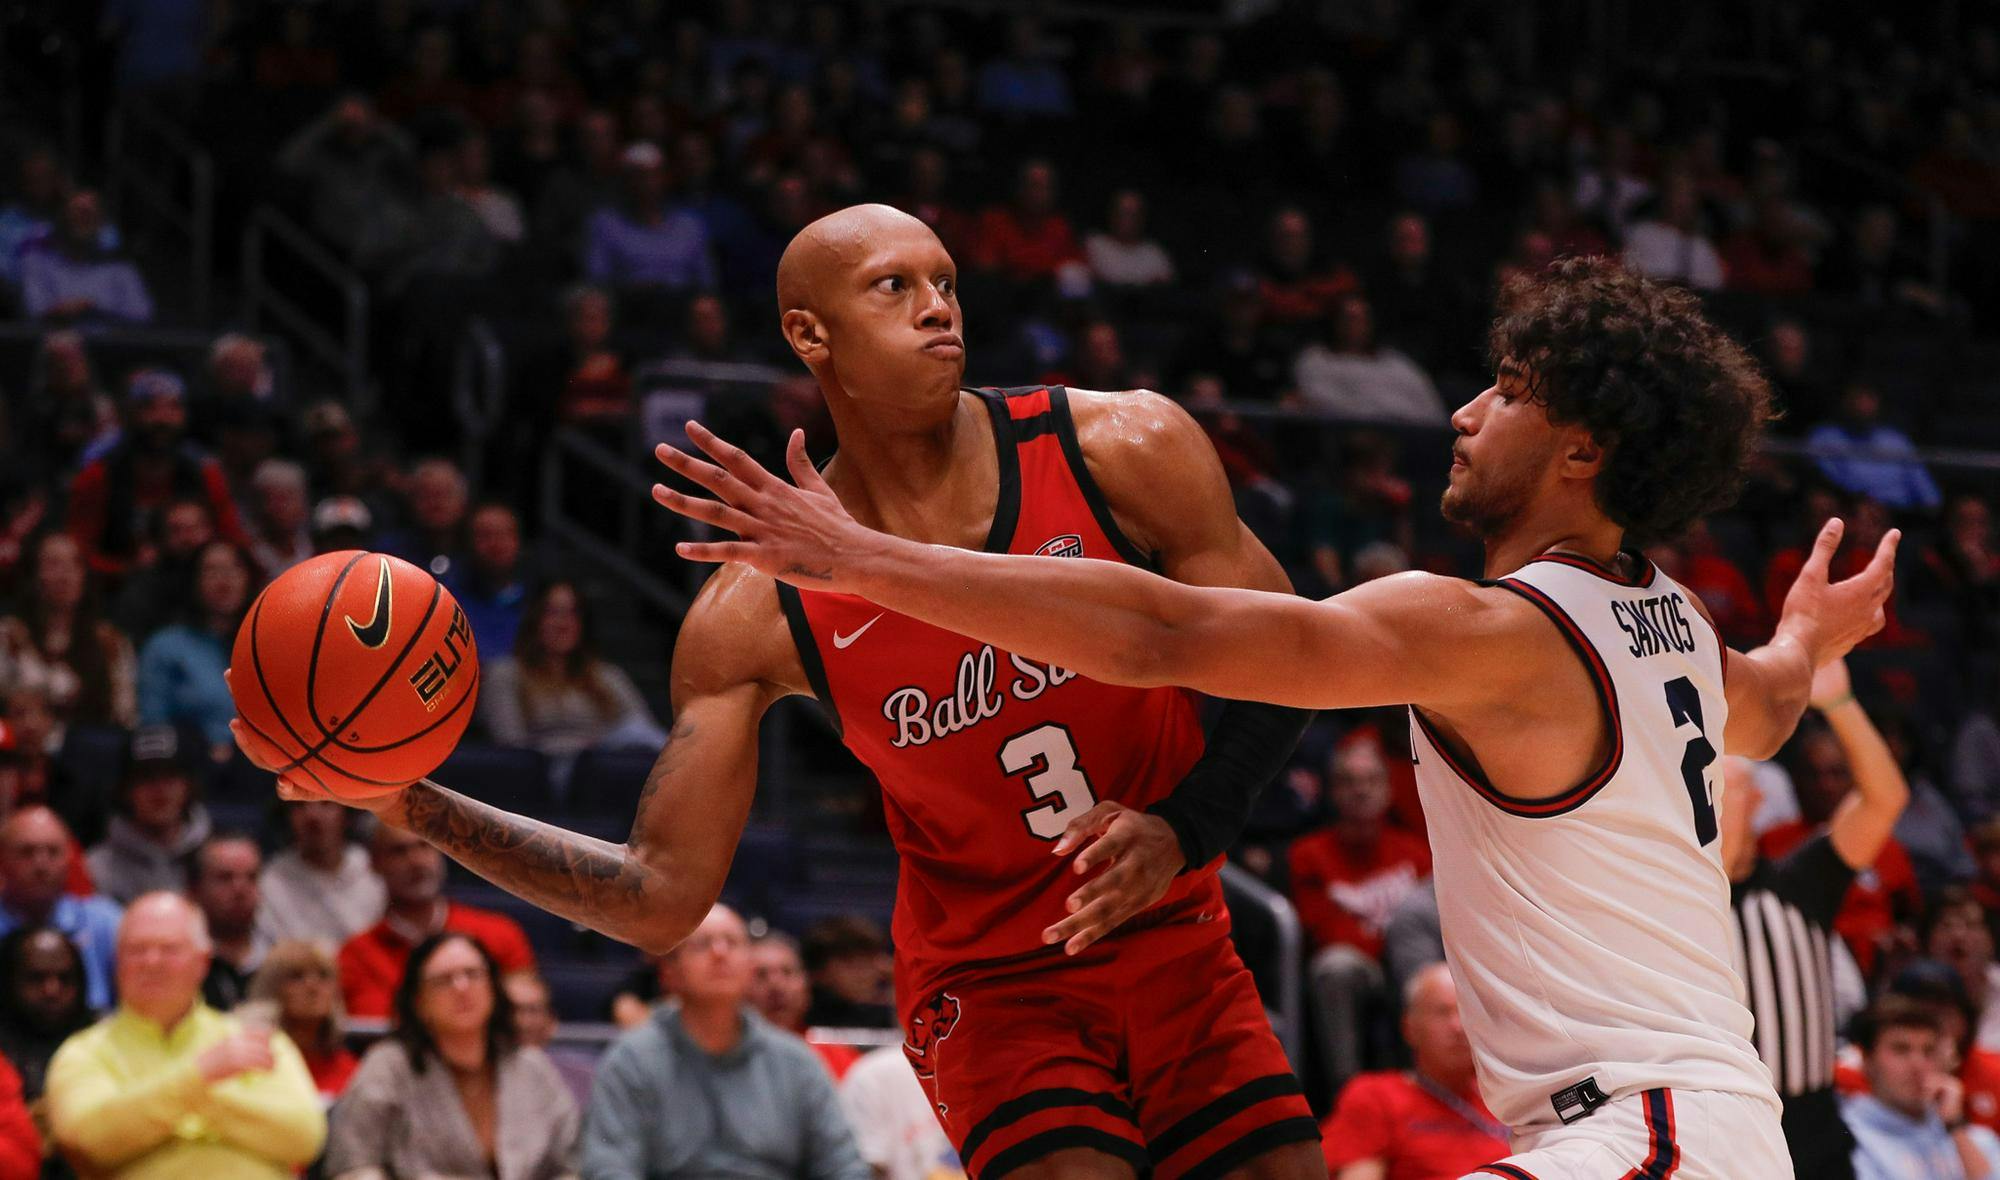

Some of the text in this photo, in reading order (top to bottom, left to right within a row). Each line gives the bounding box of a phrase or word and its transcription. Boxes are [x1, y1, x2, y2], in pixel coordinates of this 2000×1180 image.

[408, 603, 471, 705] ELITE
[882, 644, 1002, 748] Ball
[998, 722, 1099, 841] 3
[1664, 675, 1717, 848] 2
